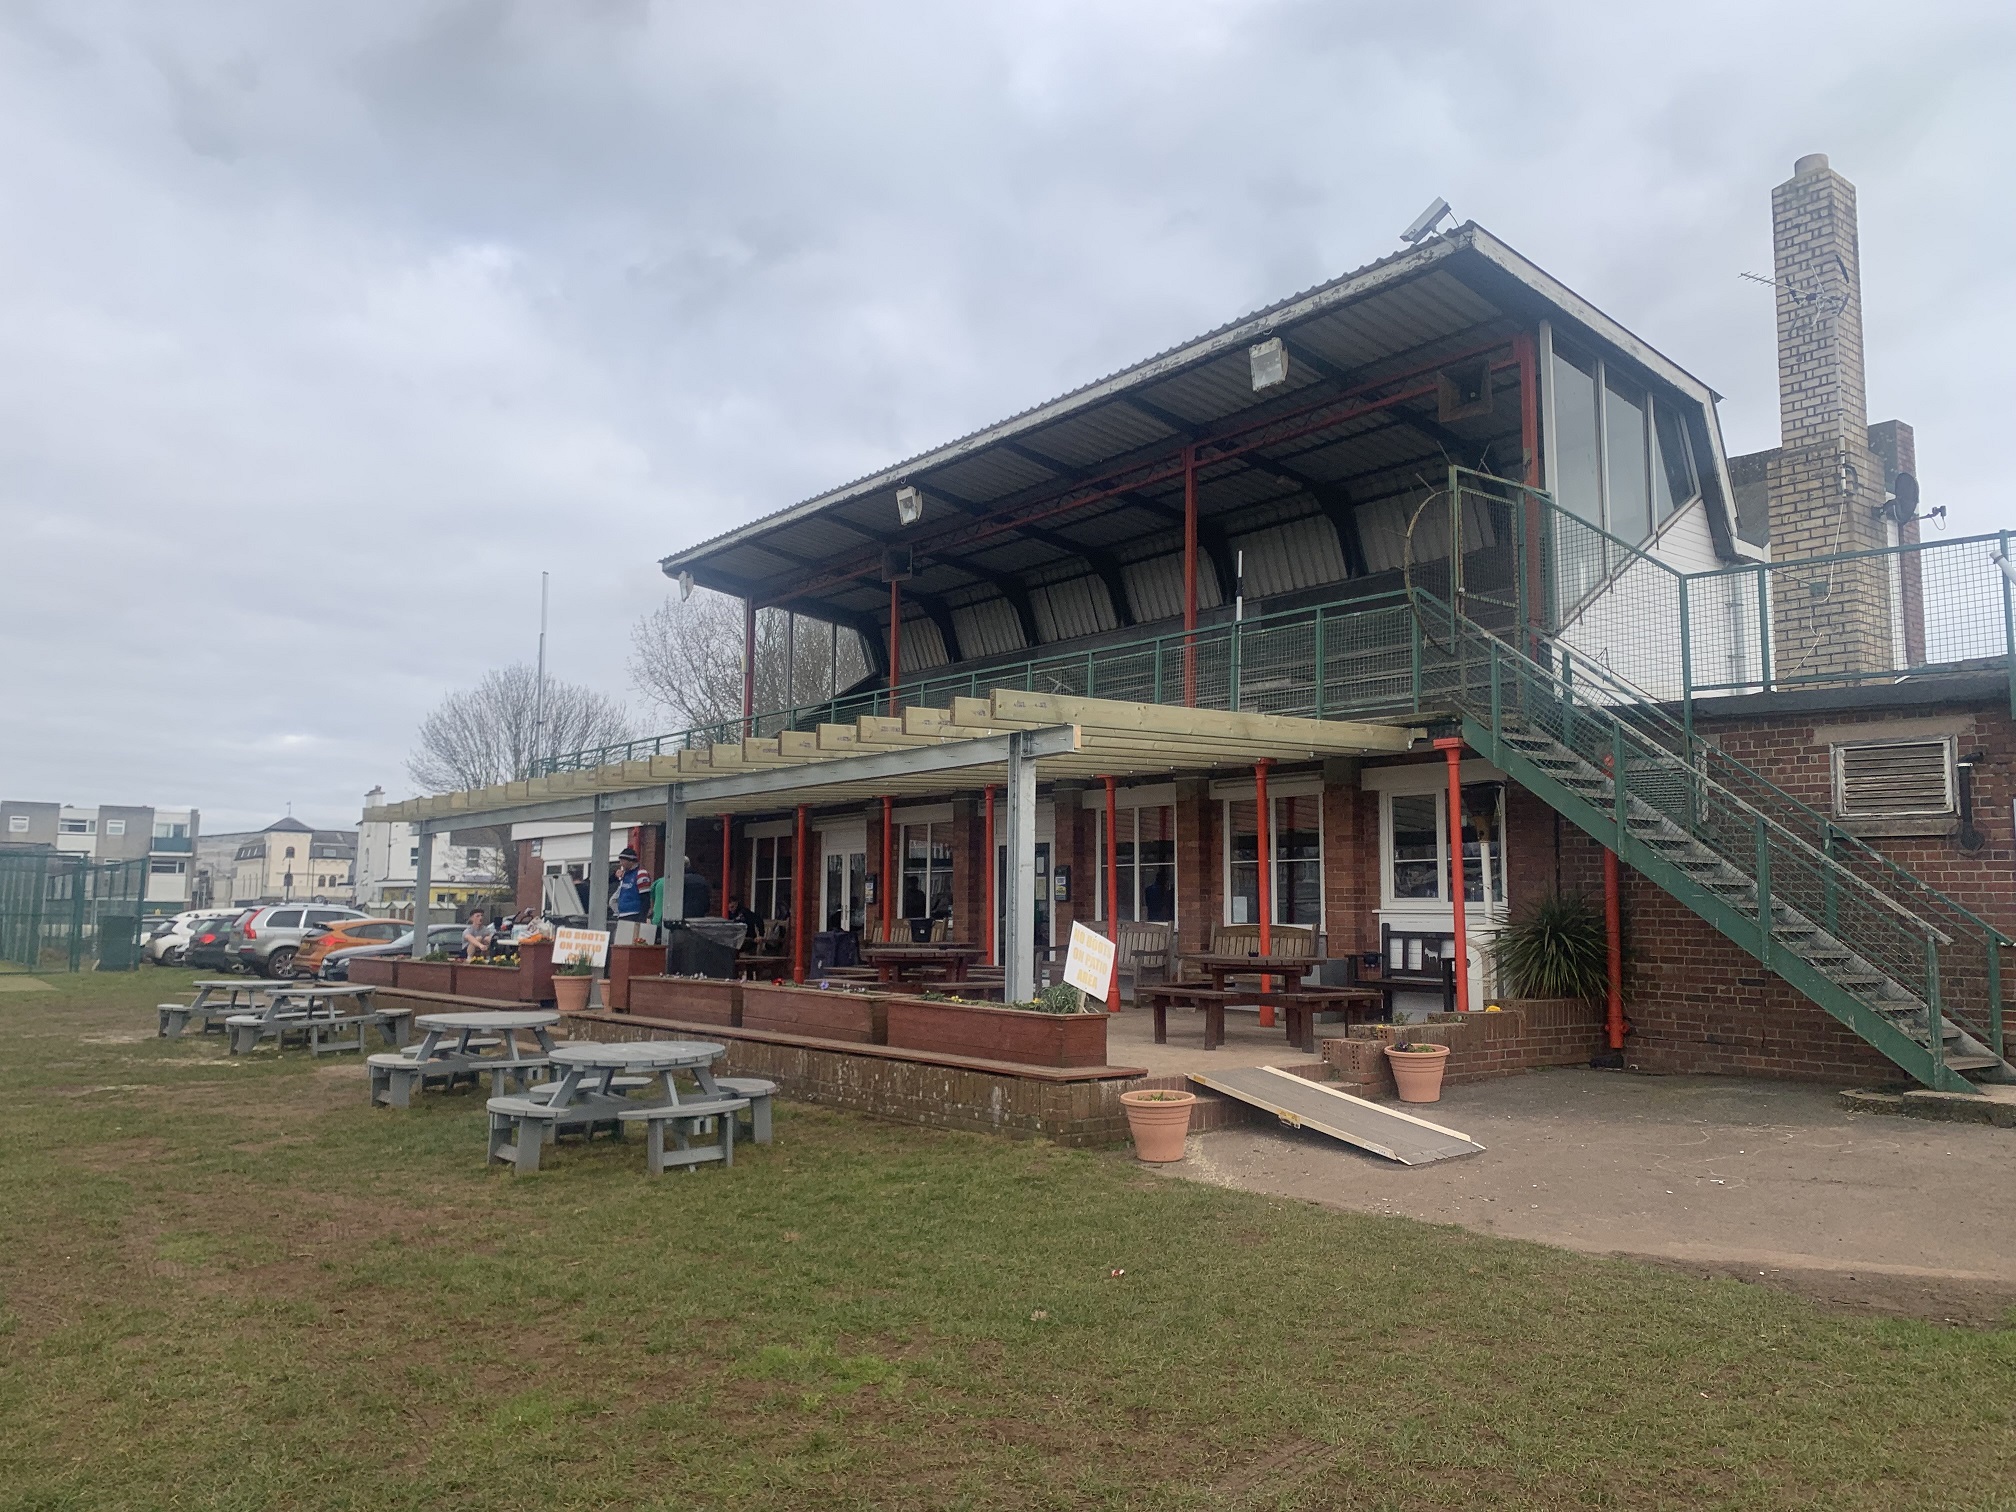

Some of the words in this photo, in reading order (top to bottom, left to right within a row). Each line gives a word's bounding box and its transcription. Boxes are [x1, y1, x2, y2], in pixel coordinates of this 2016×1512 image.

[559, 931, 571, 939] NO
[574, 932, 605, 941] BOOTS
[1074, 928, 1085, 944] NO
[1086, 935, 1111, 959] BOOTS
[575, 943, 601, 952] PATIO
[1073, 947, 1084, 962] ON
[1085, 954, 1107, 975] PATIO
[1077, 969, 1097, 989] AREA
